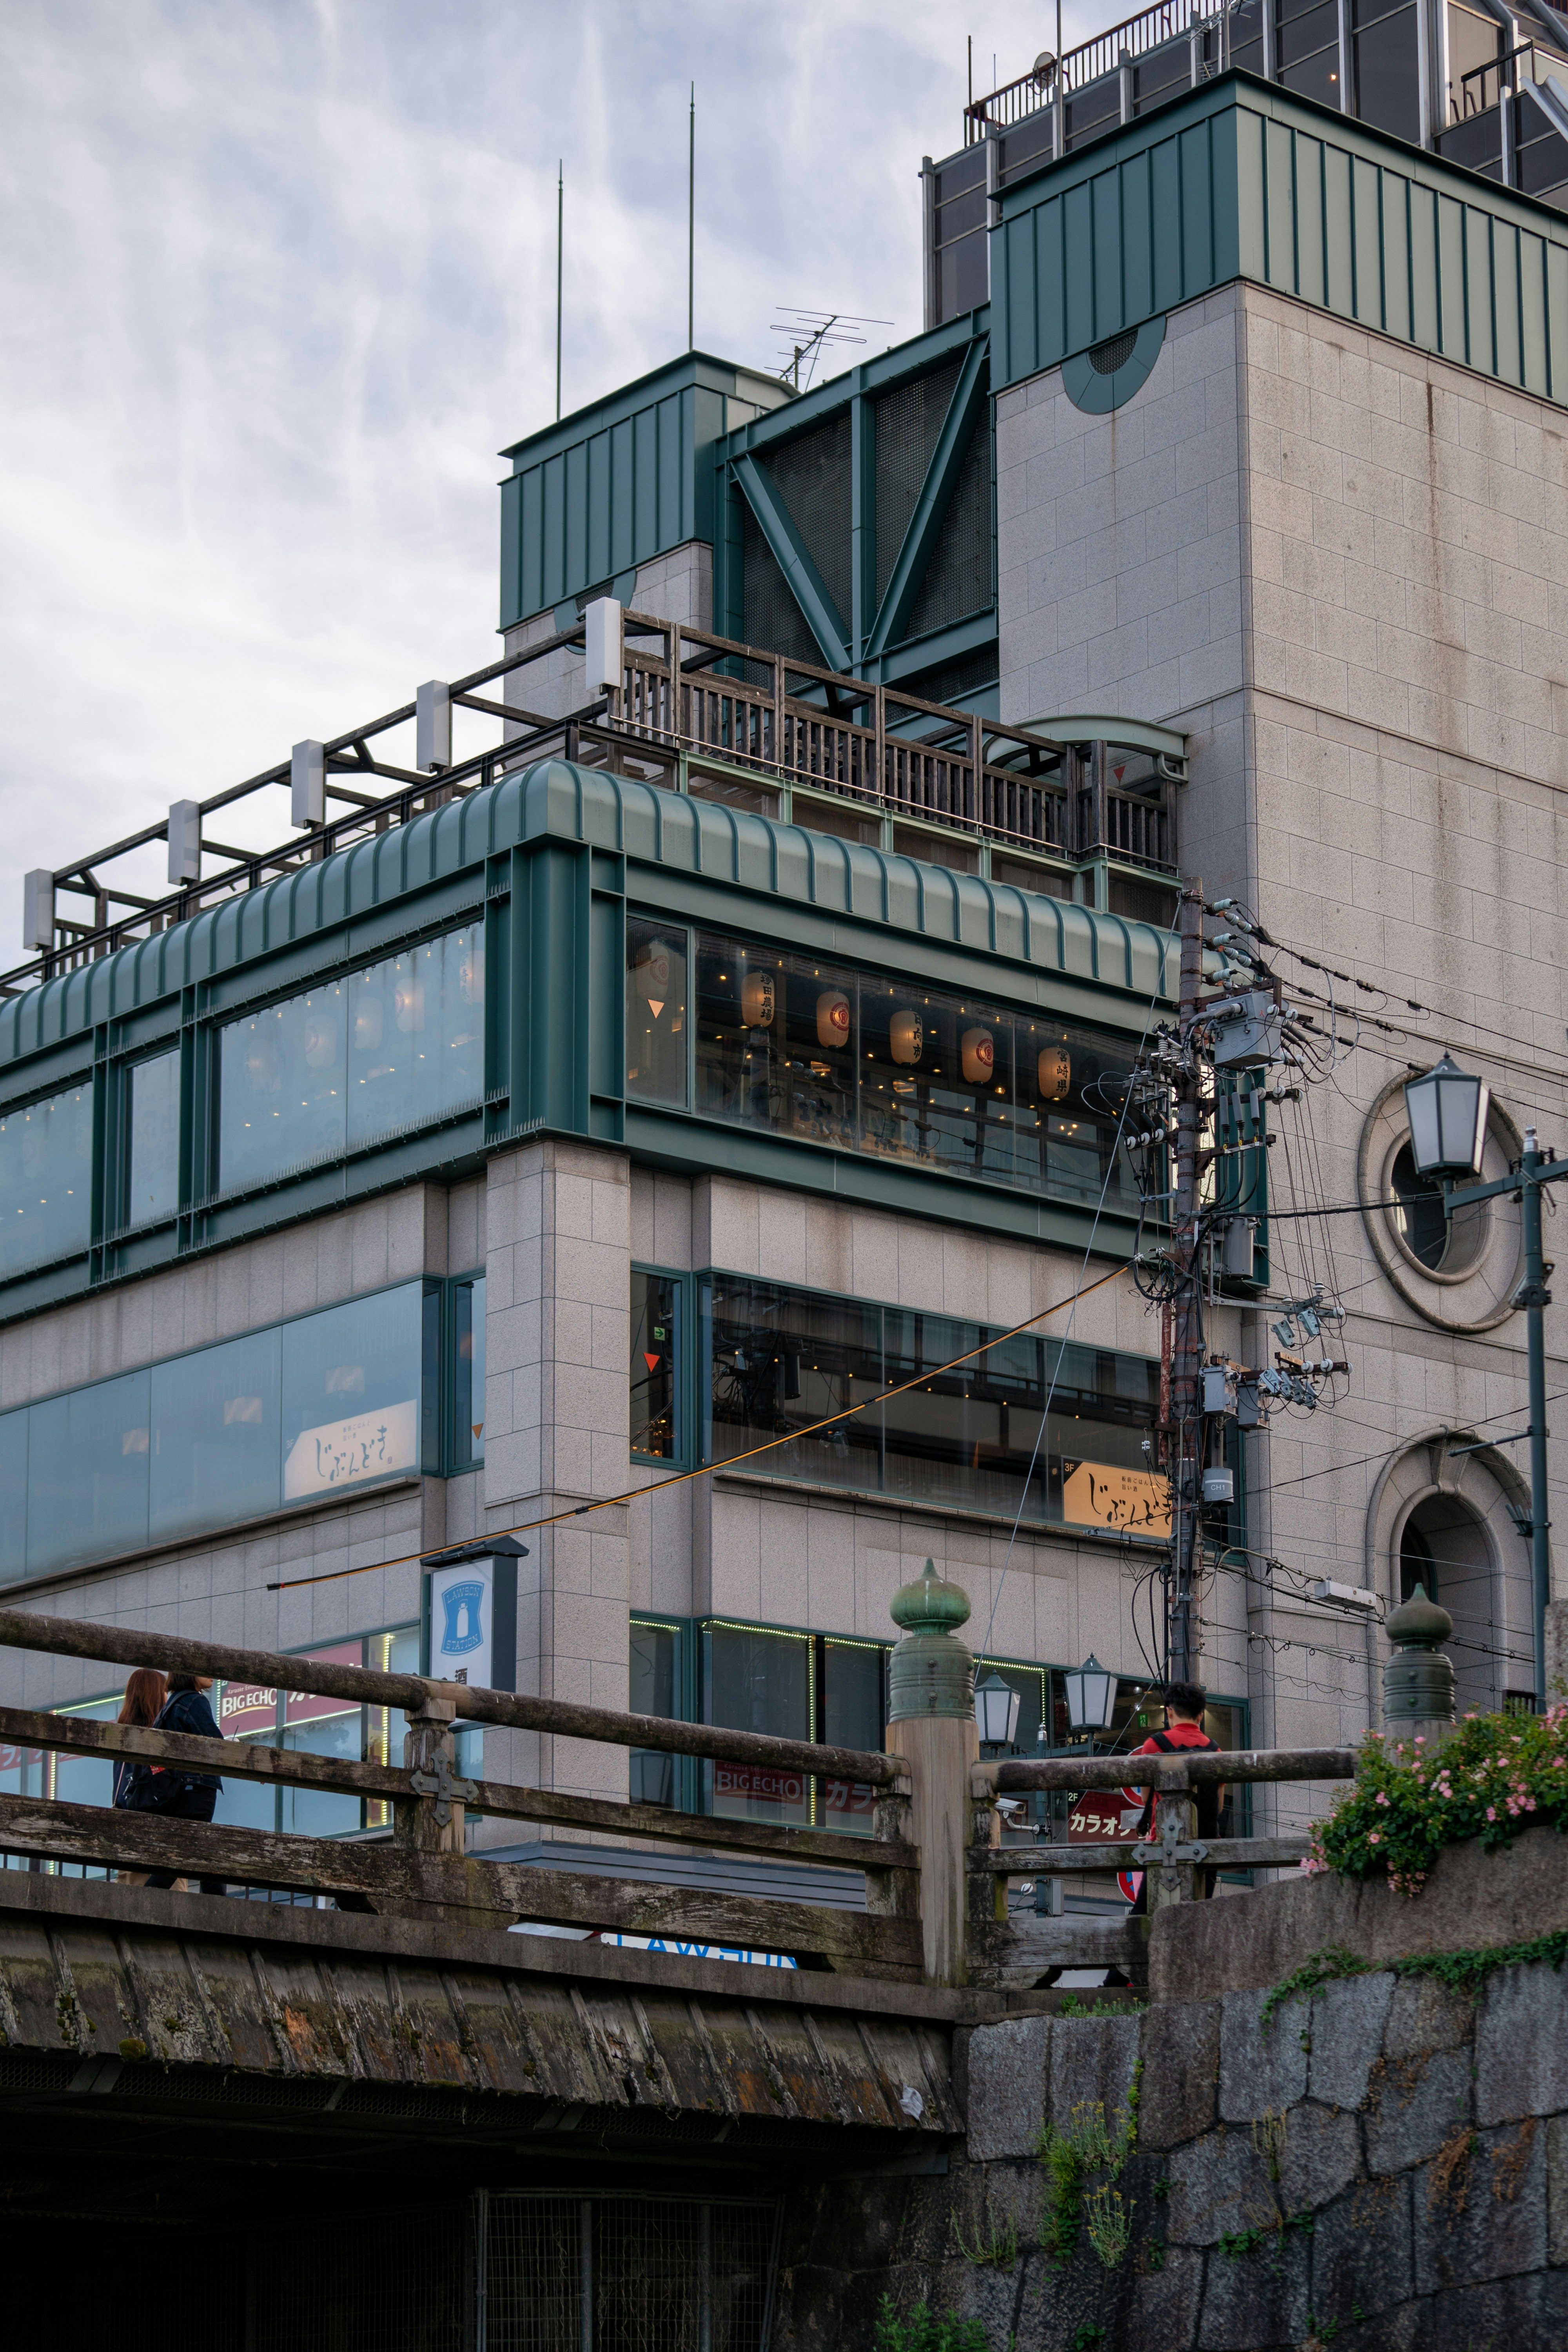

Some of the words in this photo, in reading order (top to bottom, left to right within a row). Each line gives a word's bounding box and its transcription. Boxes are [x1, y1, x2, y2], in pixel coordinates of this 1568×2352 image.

[913, 1013, 922, 1058] 日向市
[1056, 1049, 1069, 1092] 宮崎県
[286, 1439, 294, 1449] 3F
[316, 1425, 387, 1481] じぶんどき
[1065, 1463, 1074, 1472] 3F
[1089, 1473, 1172, 1526] じぶんどき
[446, 1587, 480, 1604] LAWSON
[446, 1633, 478, 1650] STATION
[222, 1695, 245, 1718] BIG
[717, 1771, 750, 1791] BIG
[753, 1776, 801, 1799] ECHO
[1068, 1793, 1078, 1802] 2F
